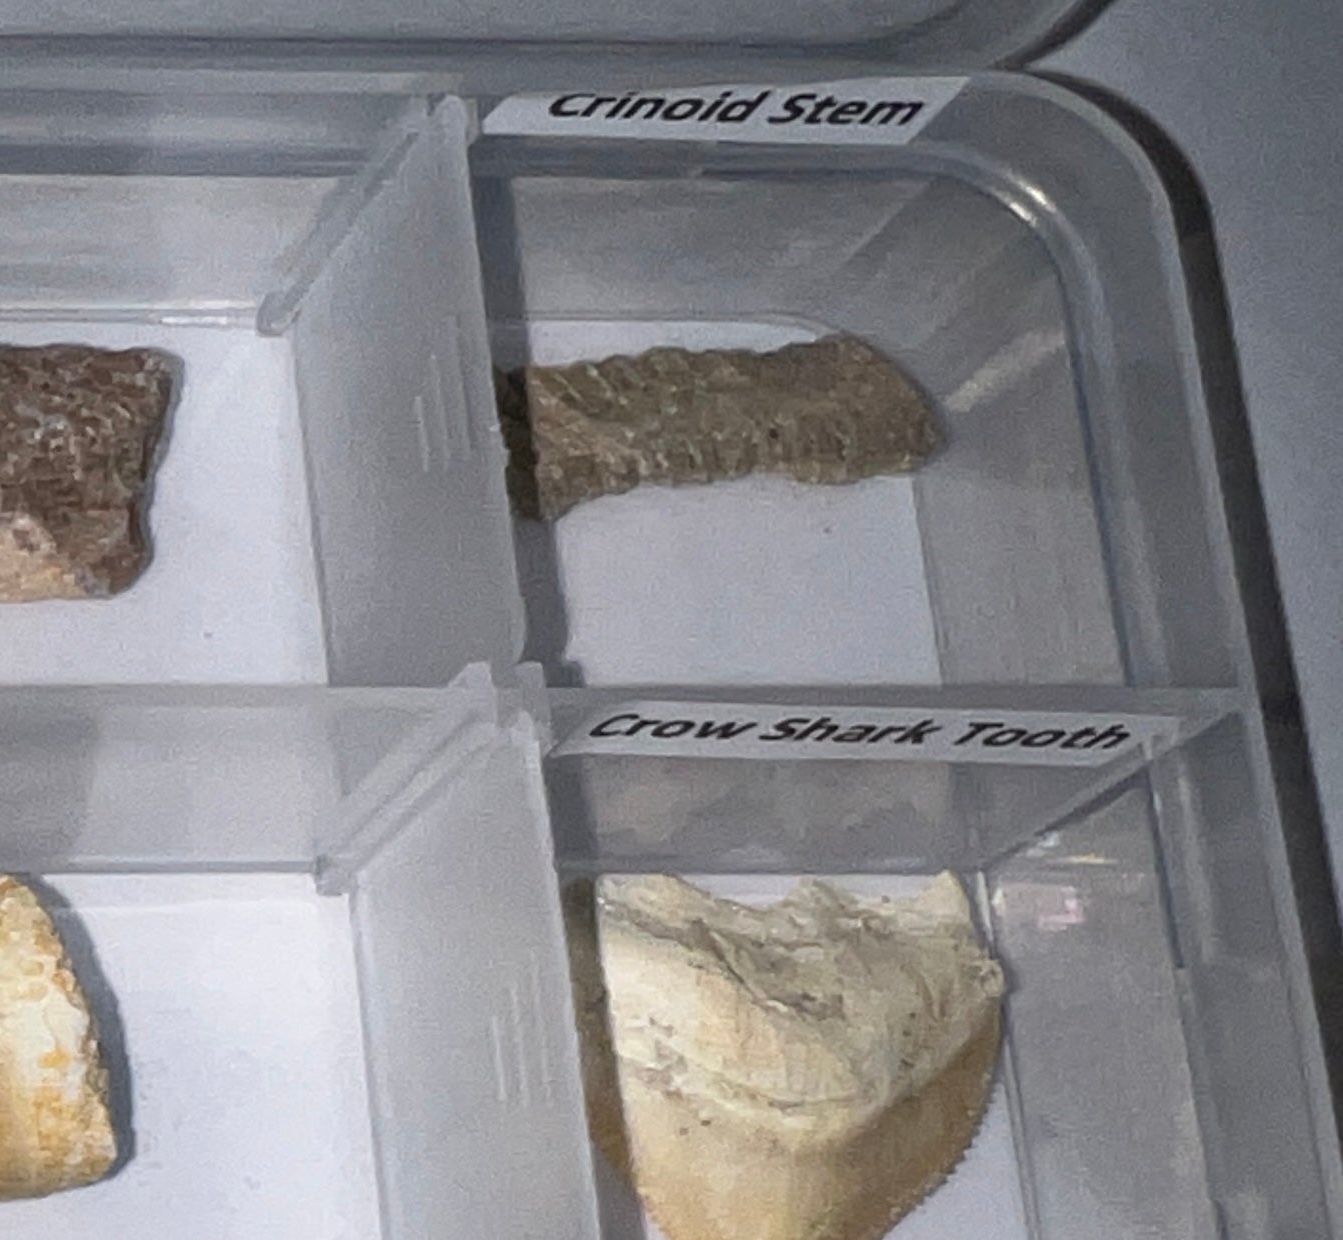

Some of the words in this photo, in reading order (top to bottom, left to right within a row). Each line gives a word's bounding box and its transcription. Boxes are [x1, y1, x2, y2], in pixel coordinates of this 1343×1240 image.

[548, 88, 771, 123] Crinoid
[767, 92, 924, 126] Stem
[588, 713, 757, 740] Crow
[758, 716, 944, 746] Shark
[952, 721, 1133, 751] Tooth
